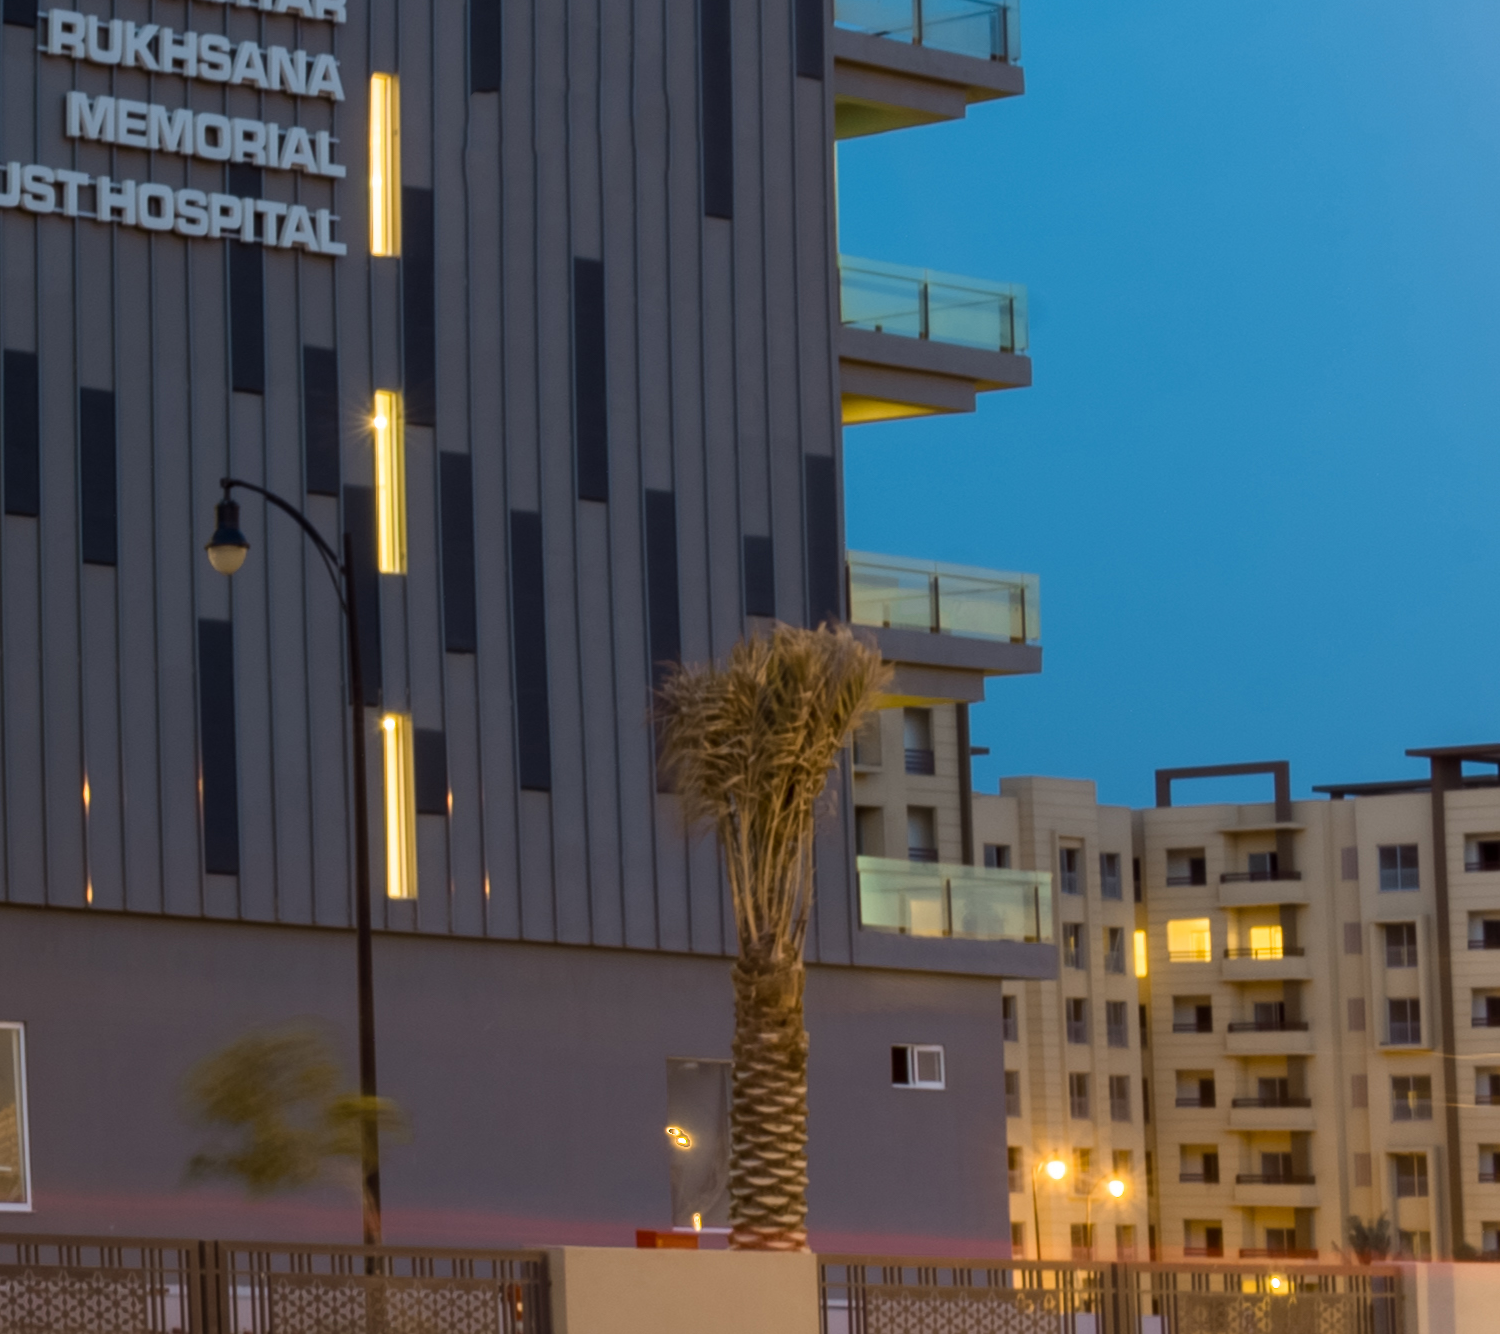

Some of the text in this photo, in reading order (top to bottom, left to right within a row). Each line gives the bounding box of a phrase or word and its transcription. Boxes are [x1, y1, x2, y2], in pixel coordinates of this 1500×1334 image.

[47, 8, 346, 101] RUKHSANA
[66, 91, 347, 178] MEMORIAL
[96, 175, 347, 256] HOSPITAL
